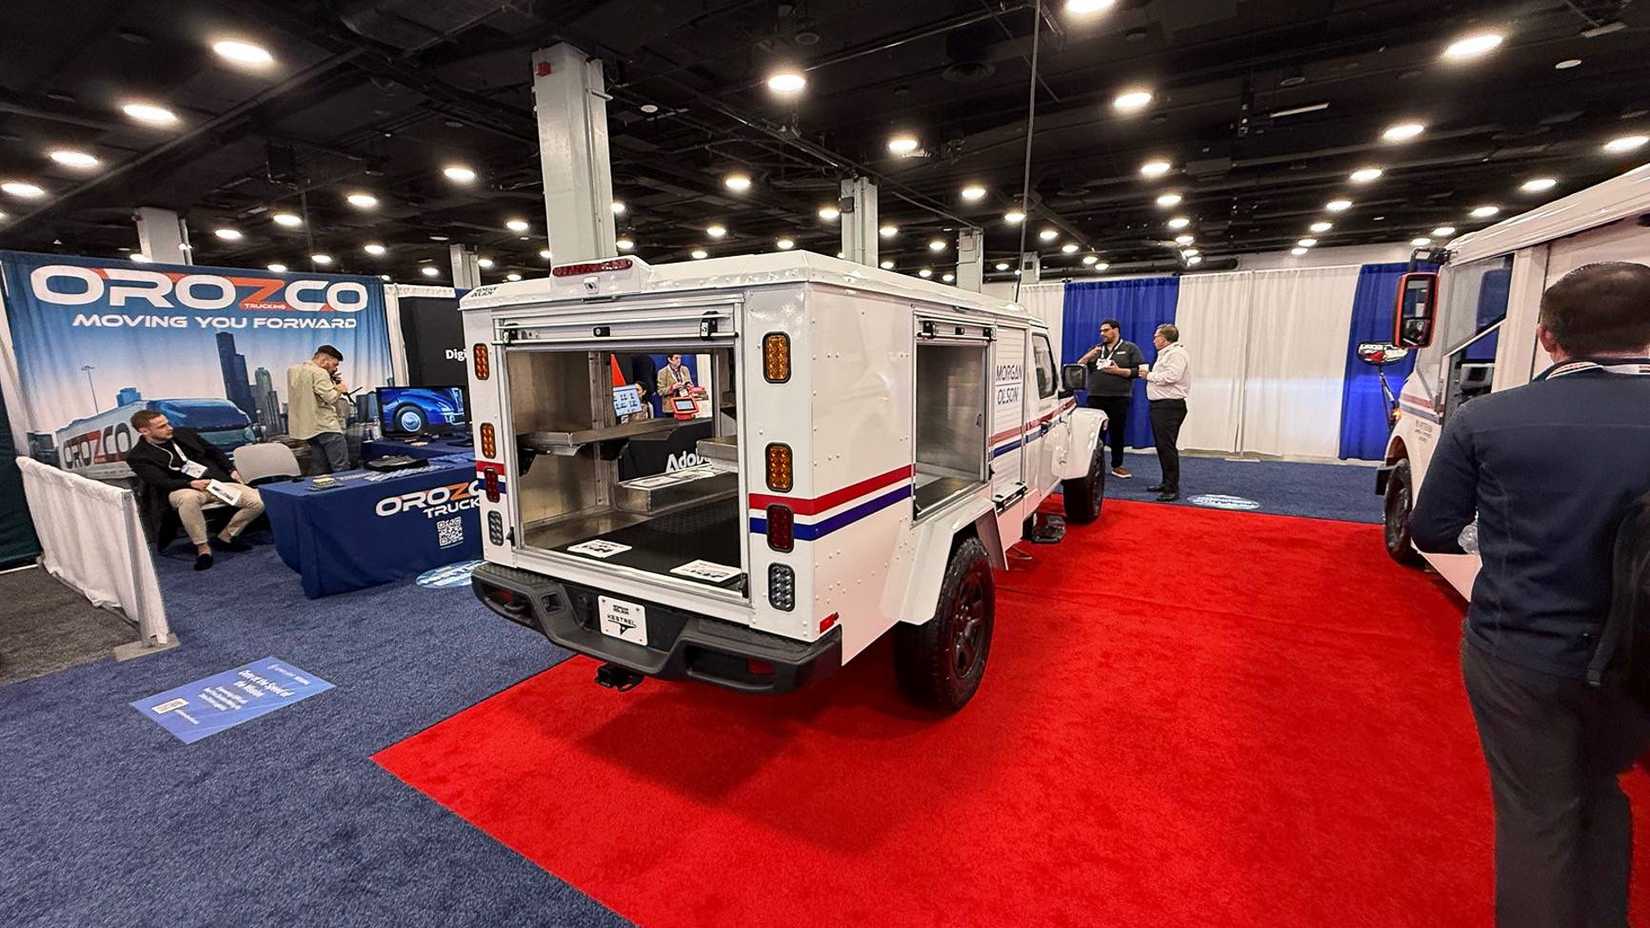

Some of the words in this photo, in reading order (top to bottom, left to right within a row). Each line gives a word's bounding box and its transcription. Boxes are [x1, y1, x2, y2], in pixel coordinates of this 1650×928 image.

[30, 265, 368, 312] OROZCO
[72, 313, 188, 328] MOVING
[195, 316, 248, 329] YOU
[253, 317, 357, 329] FORWARD
[996, 364, 1022, 381] MORGAN
[997, 387, 1018, 405] OLSON
[63, 421, 132, 469] OROZCO
